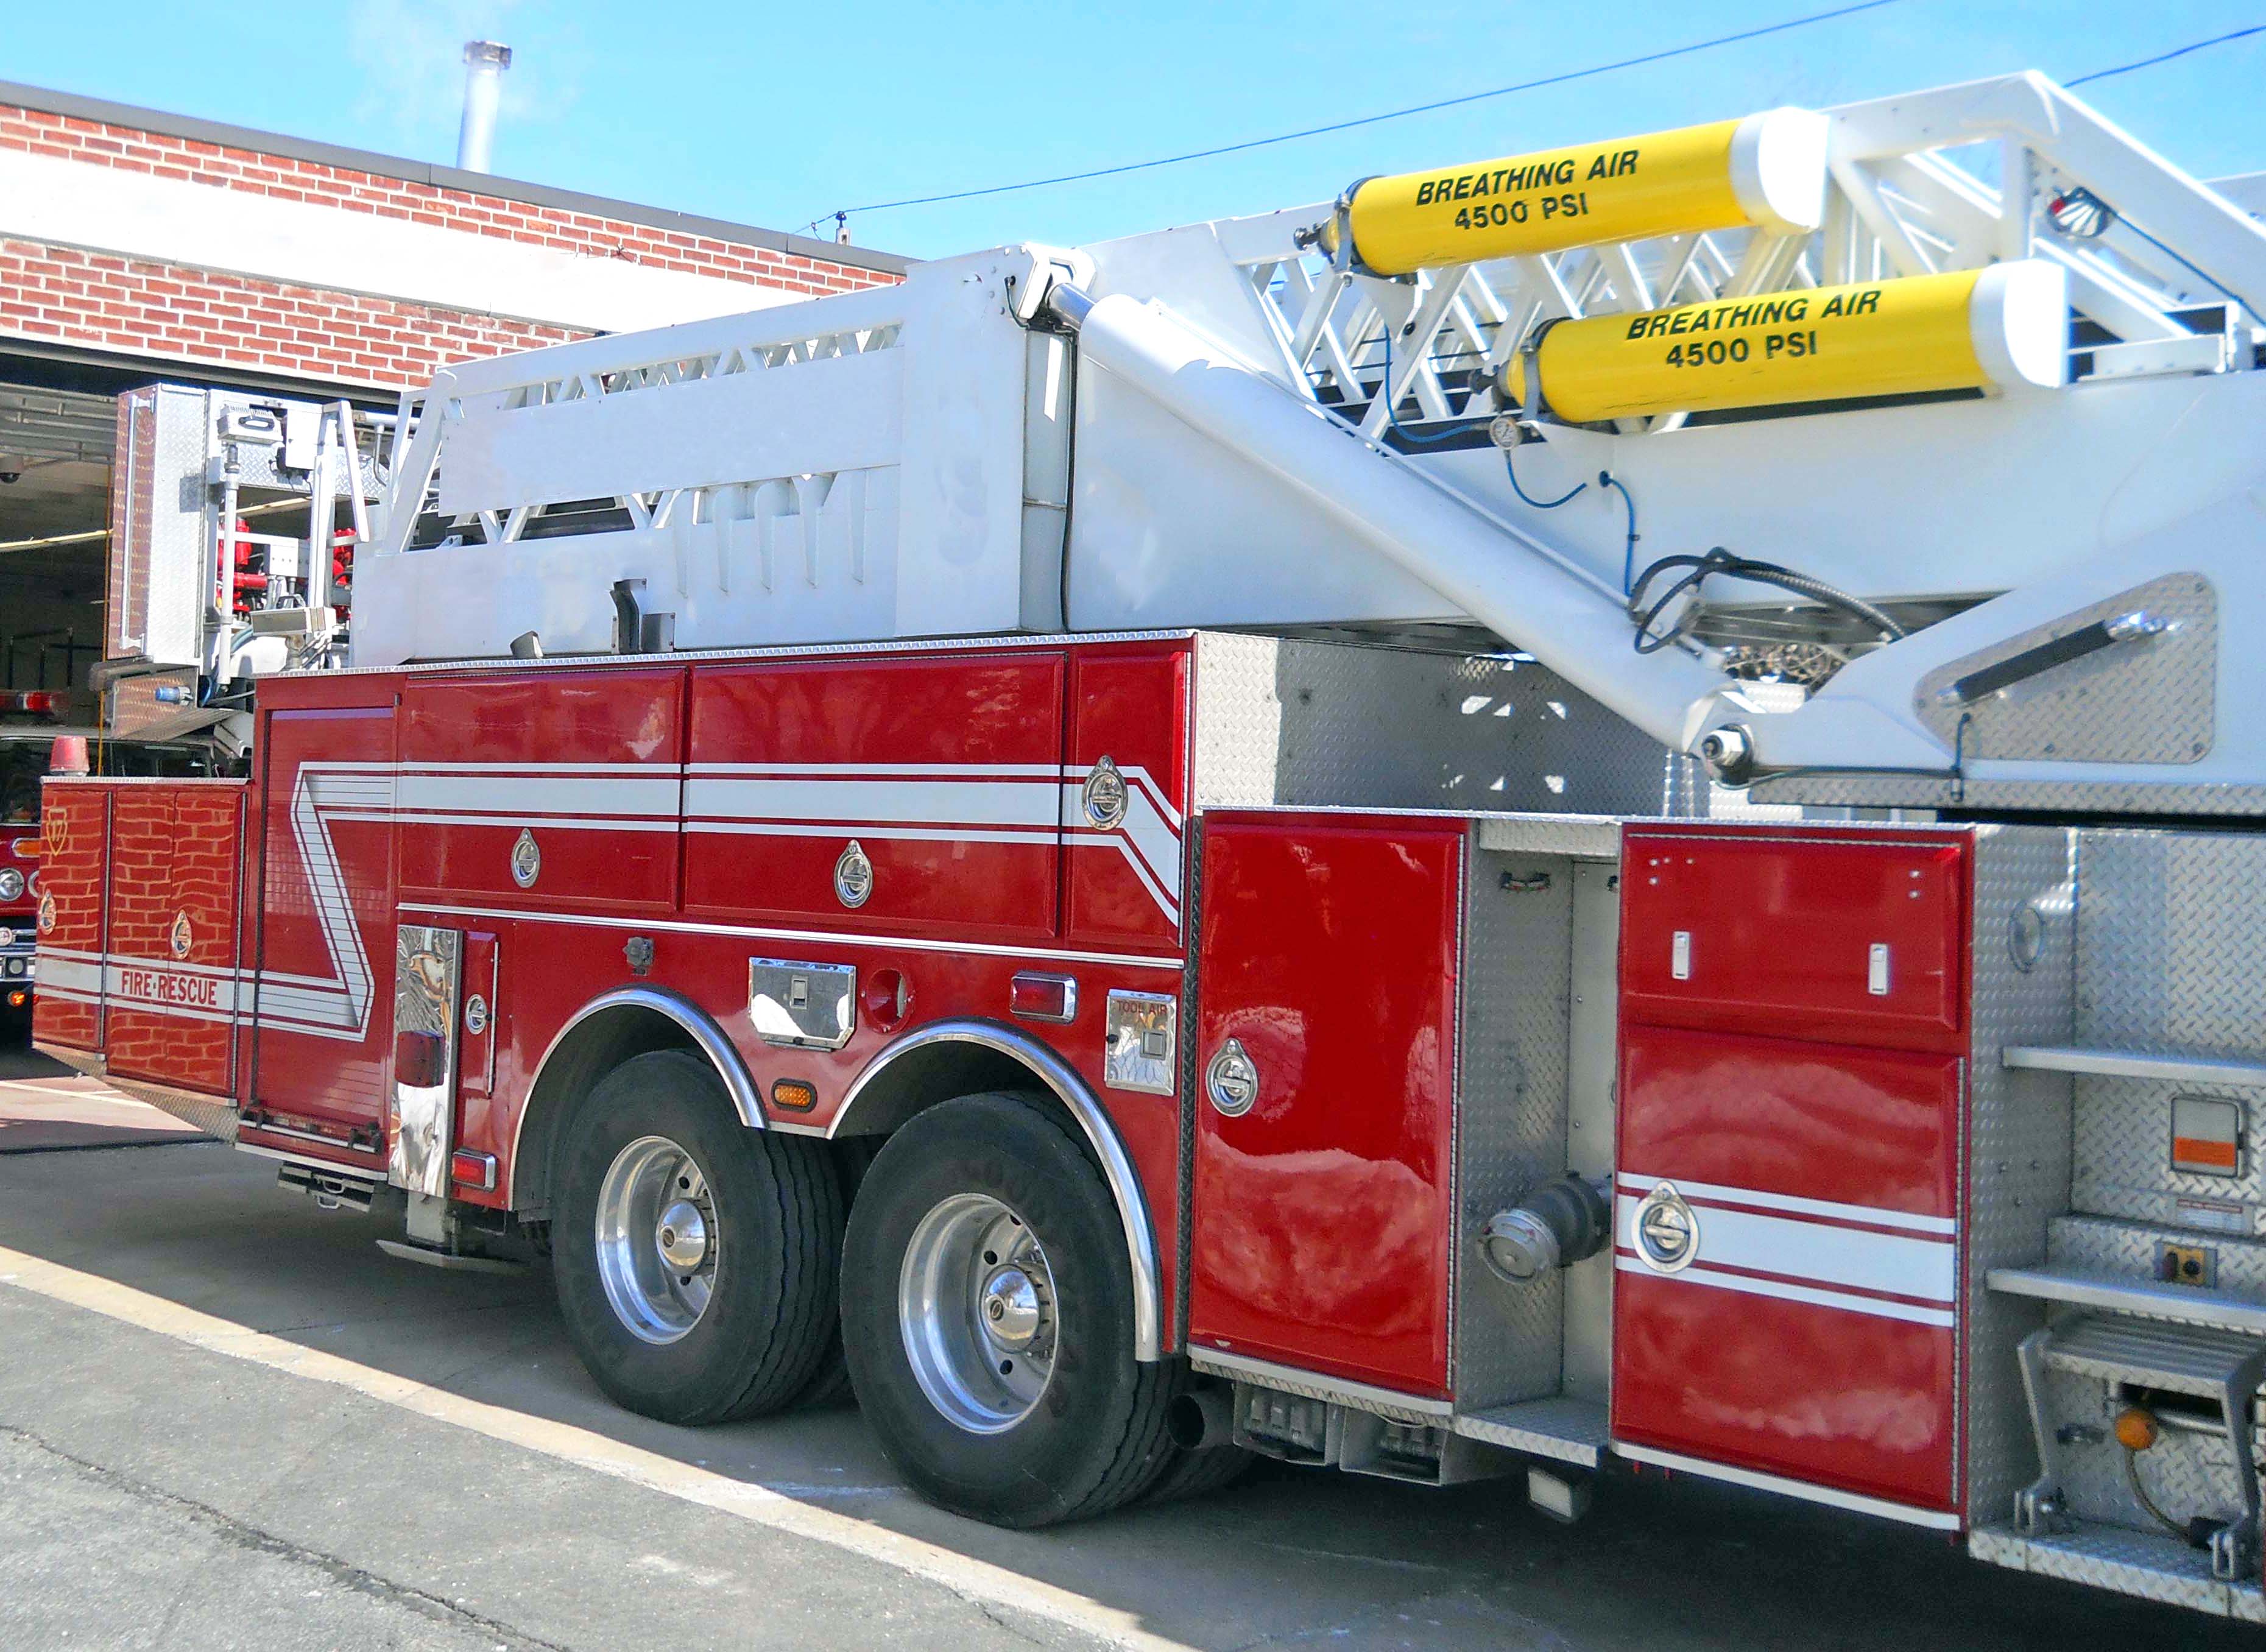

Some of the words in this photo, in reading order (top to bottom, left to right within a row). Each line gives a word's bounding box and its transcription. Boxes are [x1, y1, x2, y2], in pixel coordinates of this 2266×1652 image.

[1416, 158, 1575, 206] BREATHING
[1587, 149, 1639, 181] AIR
[1455, 200, 1528, 230] 4500
[1542, 192, 1589, 219] PSI
[1626, 298, 1809, 340] BREATHING
[1821, 290, 1882, 318] AIR
[1666, 338, 1749, 368] 4500
[1766, 331, 1817, 359] PSI
[1117, 1000, 1143, 1013] TOOL
[1149, 1004, 1168, 1015] AIR
